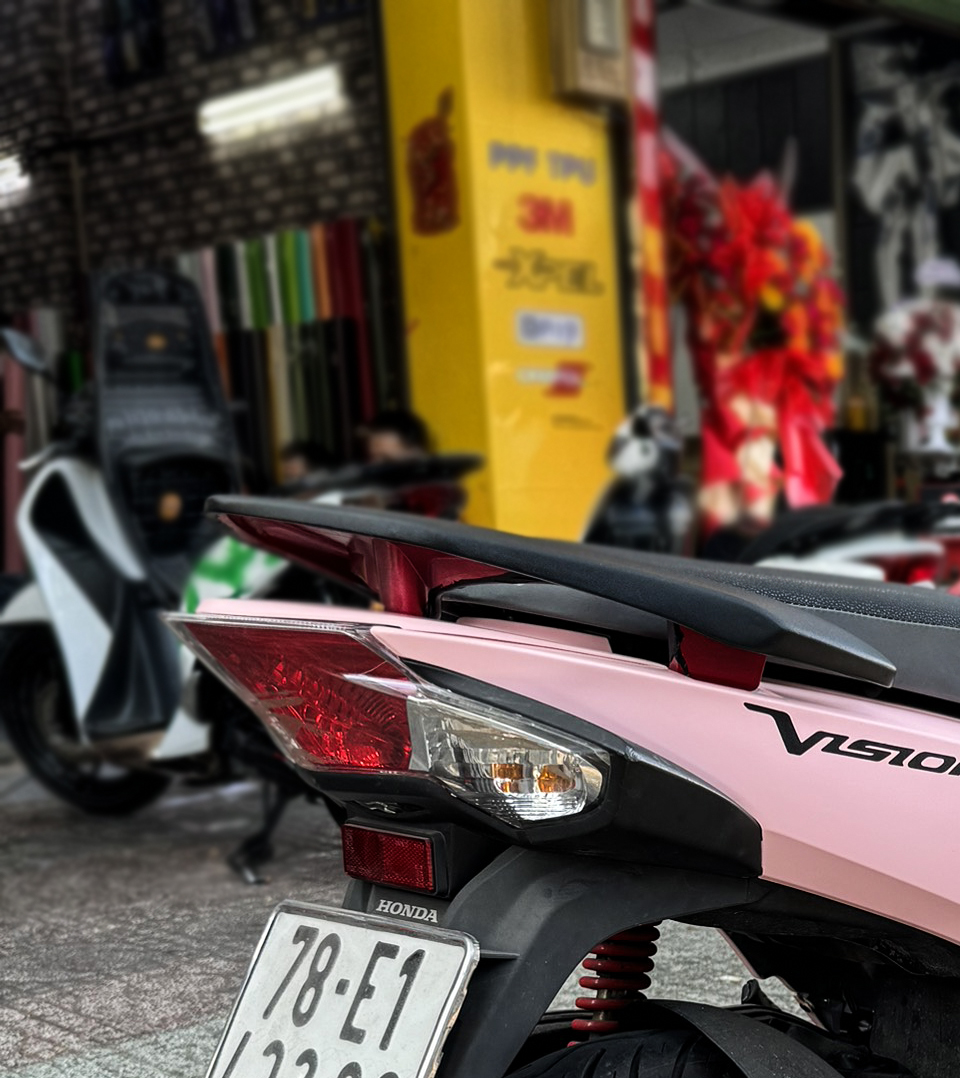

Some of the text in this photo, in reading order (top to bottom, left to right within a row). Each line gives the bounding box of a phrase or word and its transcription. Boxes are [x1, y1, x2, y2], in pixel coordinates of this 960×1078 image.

[516, 192, 575, 238] 3M
[376, 899, 439, 923] HONDA
[262, 924, 425, 1051] 78-E1
